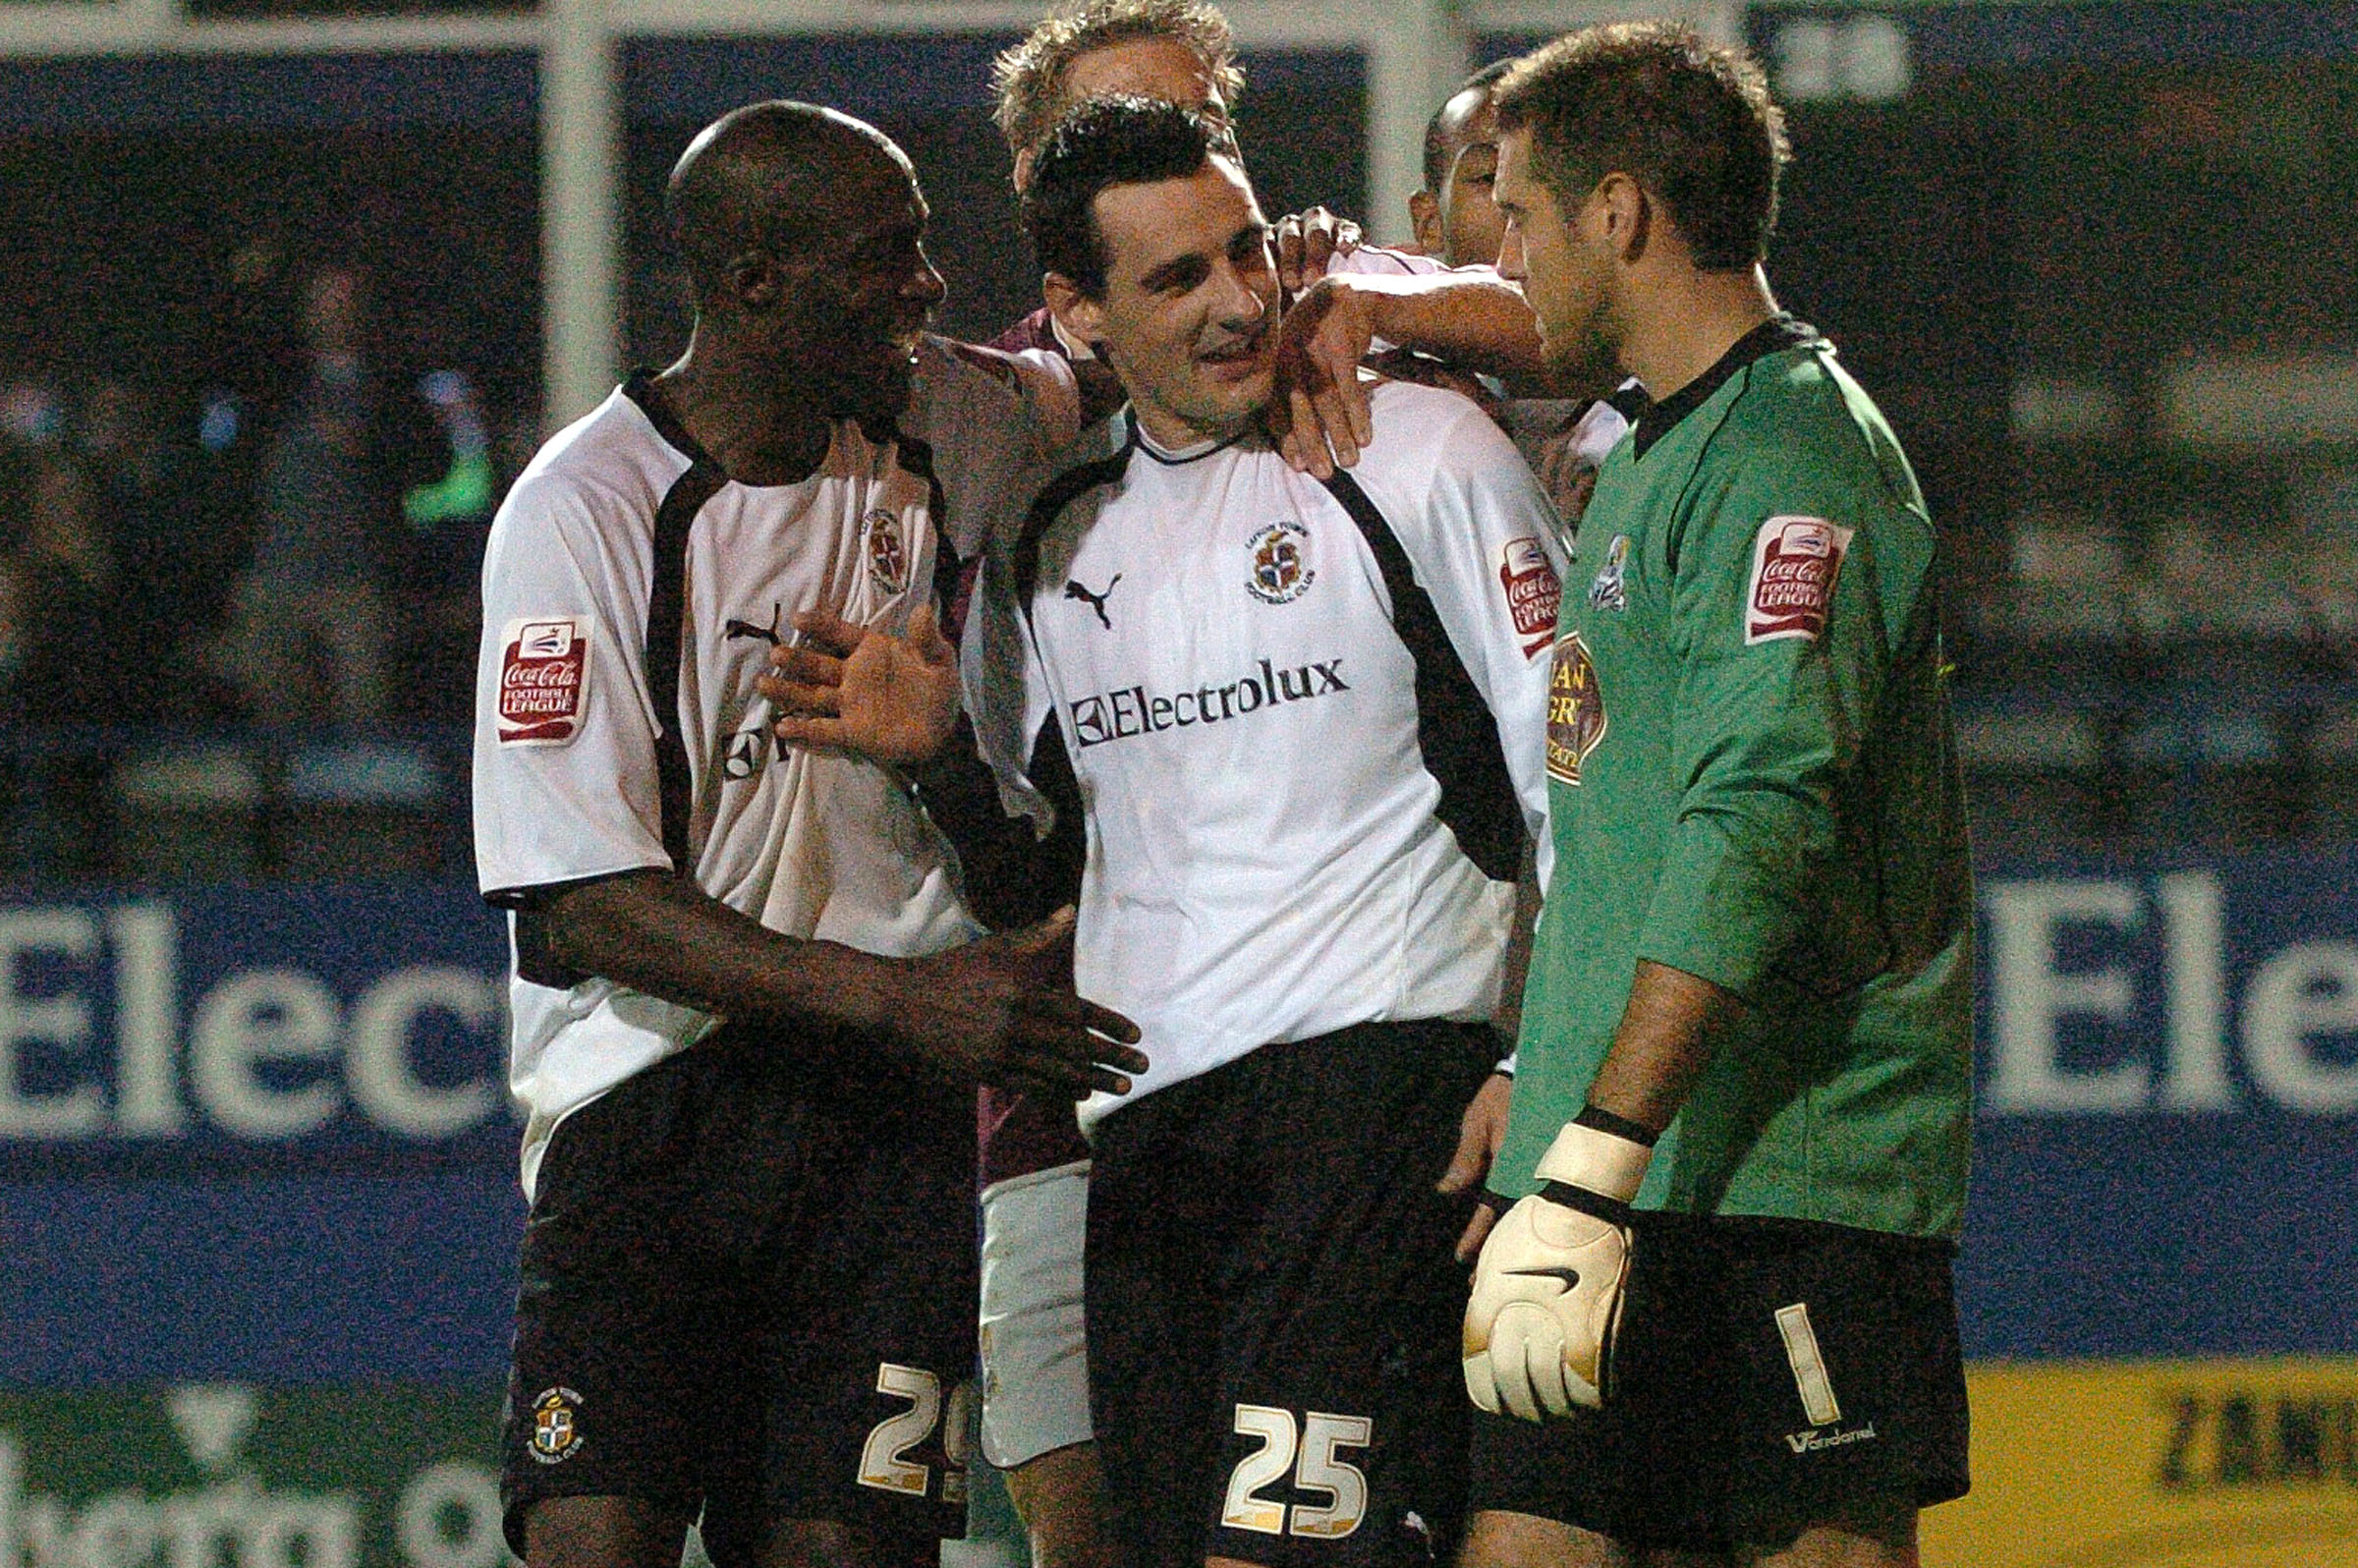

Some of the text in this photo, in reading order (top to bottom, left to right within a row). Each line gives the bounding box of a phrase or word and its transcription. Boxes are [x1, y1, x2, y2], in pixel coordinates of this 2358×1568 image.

[1109, 658, 1351, 738] Electrolux
[0, 898, 528, 1138] Elec
[1774, 1302, 1841, 1427] 1
[1220, 1403, 1374, 1540] 25
